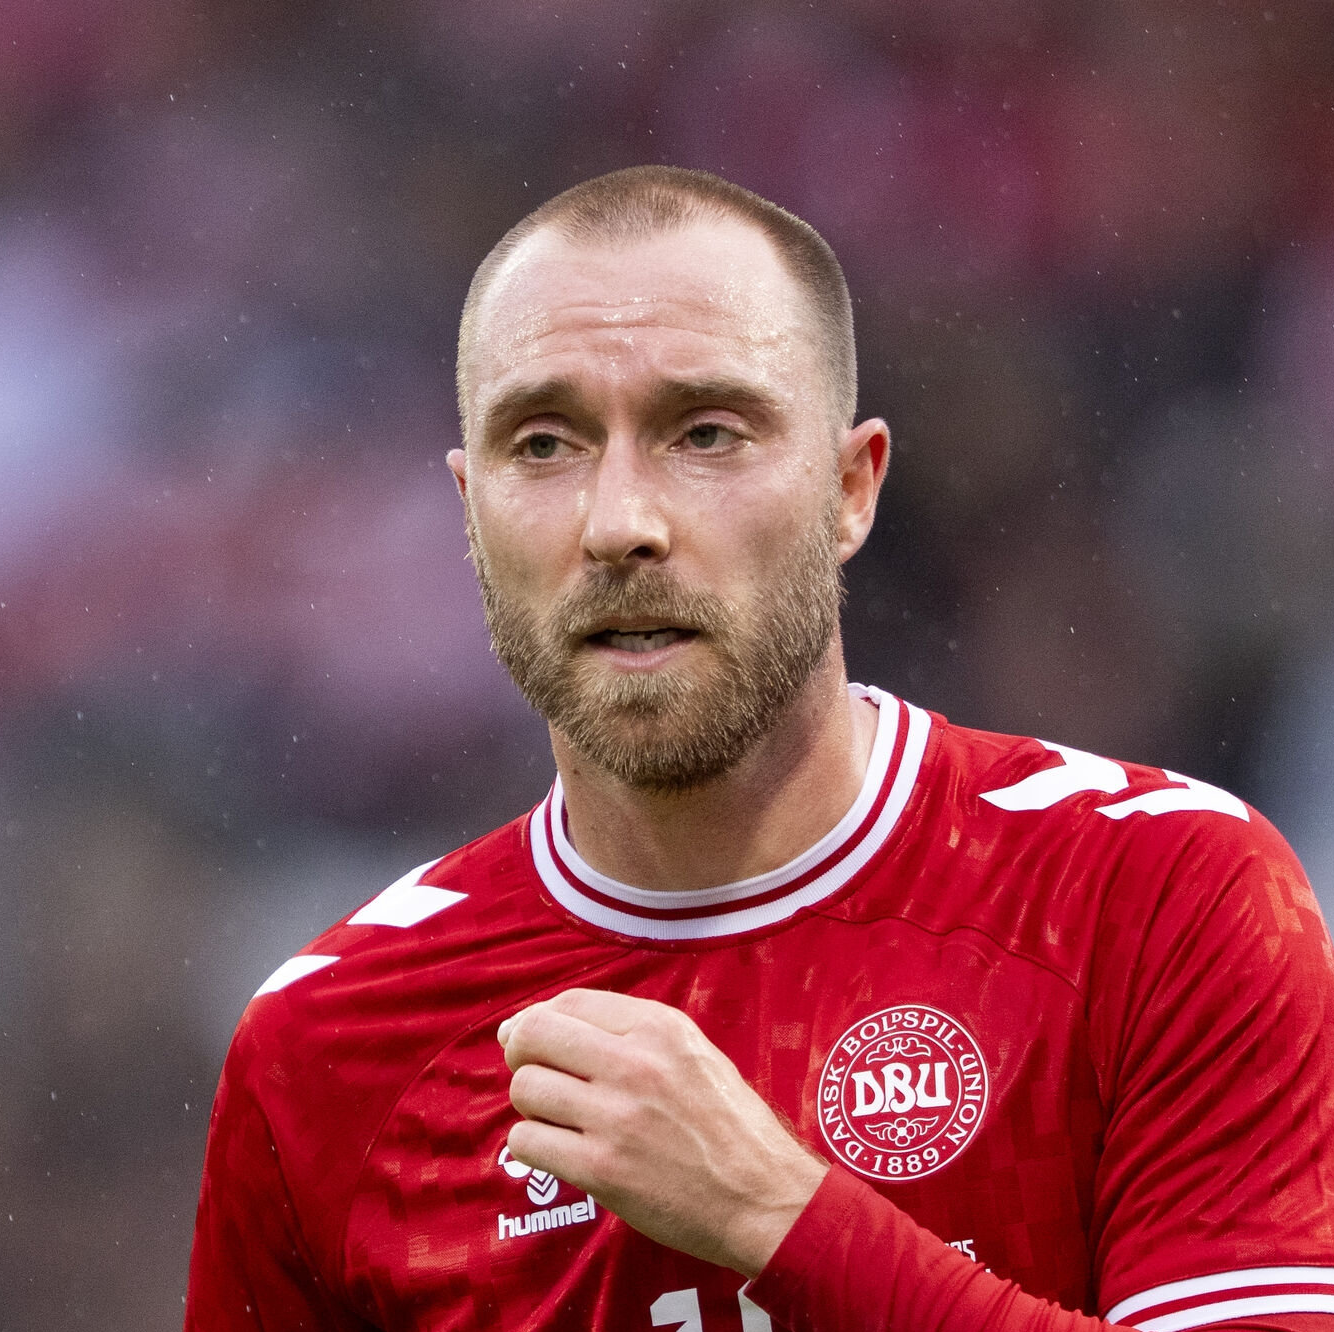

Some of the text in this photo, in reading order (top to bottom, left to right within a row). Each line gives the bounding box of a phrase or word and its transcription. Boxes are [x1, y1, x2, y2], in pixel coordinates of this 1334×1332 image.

[823, 1064, 865, 1162] DANSK
[850, 1061, 952, 1117] DBU
[871, 1147, 940, 1175] 1889
[498, 1194, 596, 1240] hummel
